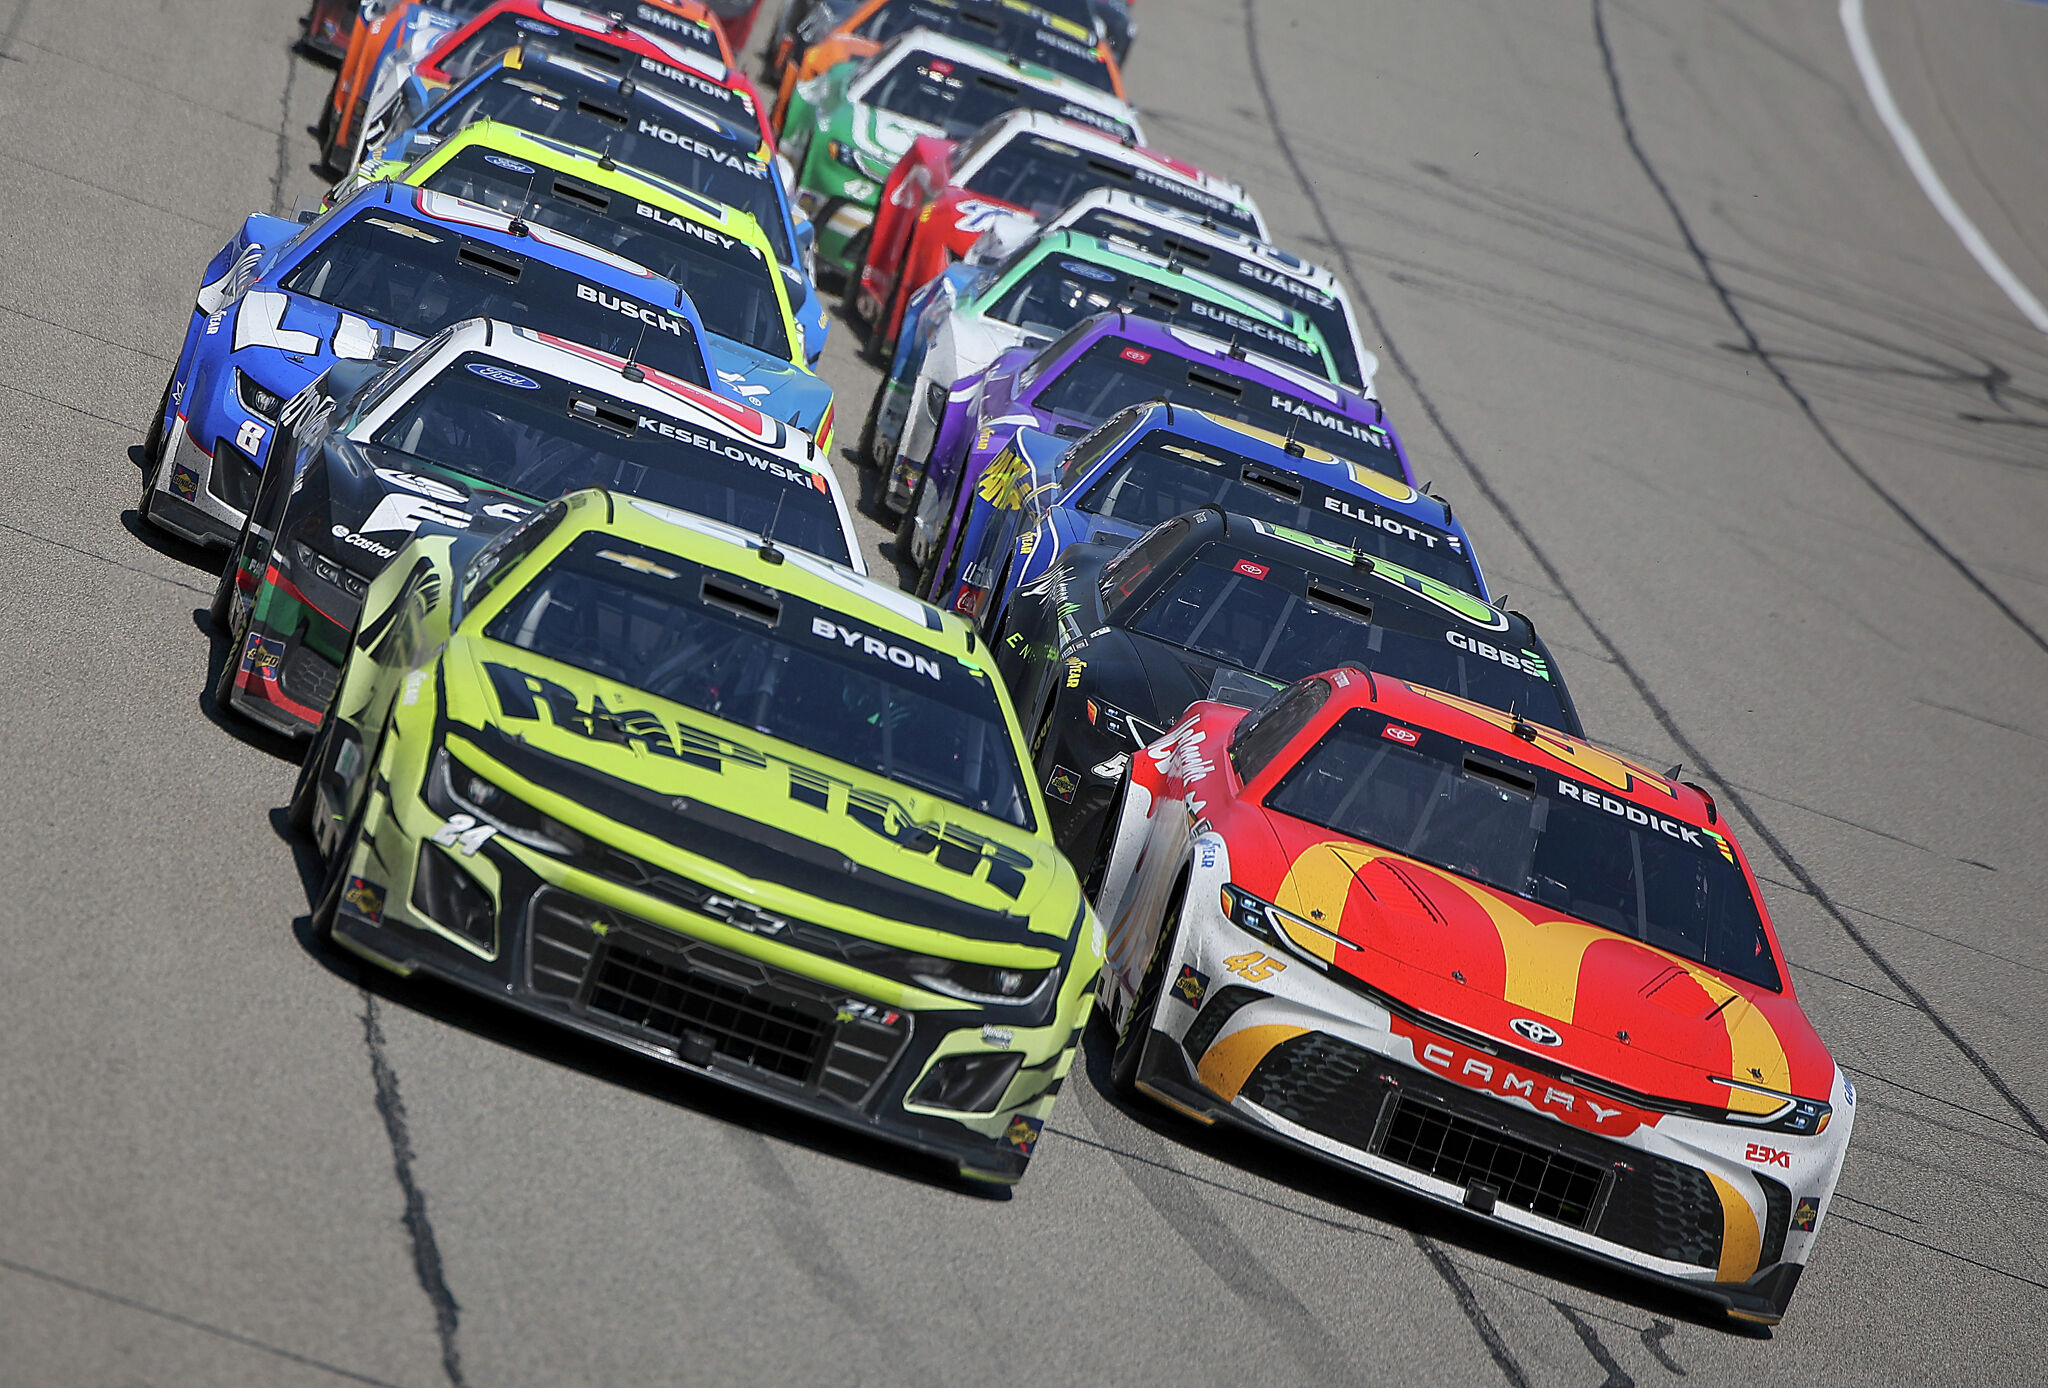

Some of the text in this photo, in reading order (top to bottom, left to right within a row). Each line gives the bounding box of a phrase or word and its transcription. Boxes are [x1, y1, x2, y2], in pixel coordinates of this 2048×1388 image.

[636, 5, 711, 45] SMITH
[640, 56, 731, 101] BURTON
[638, 118, 765, 180] HOCEVAR
[1134, 170, 1230, 213] STENHOUSE
[636, 201, 736, 251] BLANEY
[576, 283, 682, 337] BUSCH
[1191, 300, 1314, 357] BUESCHER
[235, 419, 267, 457] 8
[1271, 395, 1381, 448] HAMLIN
[638, 414, 815, 491] KESELOWSKI
[173, 476, 197, 493] SUNOCO
[344, 532, 398, 560] Castrol
[1324, 496, 1439, 548] ELLIOTT
[811, 616, 942, 681] BYRON
[1446, 629, 1542, 679] GIBBS
[481, 661, 1034, 902] RAPTOR
[431, 813, 498, 856] 24
[1558, 779, 1704, 849] REDDICK
[1176, 976, 1205, 998] SUNOCO
[1223, 951, 1288, 983] 45
[1423, 1043, 1622, 1123] CAMRY
[1745, 1143, 1795, 1169] 23XI
